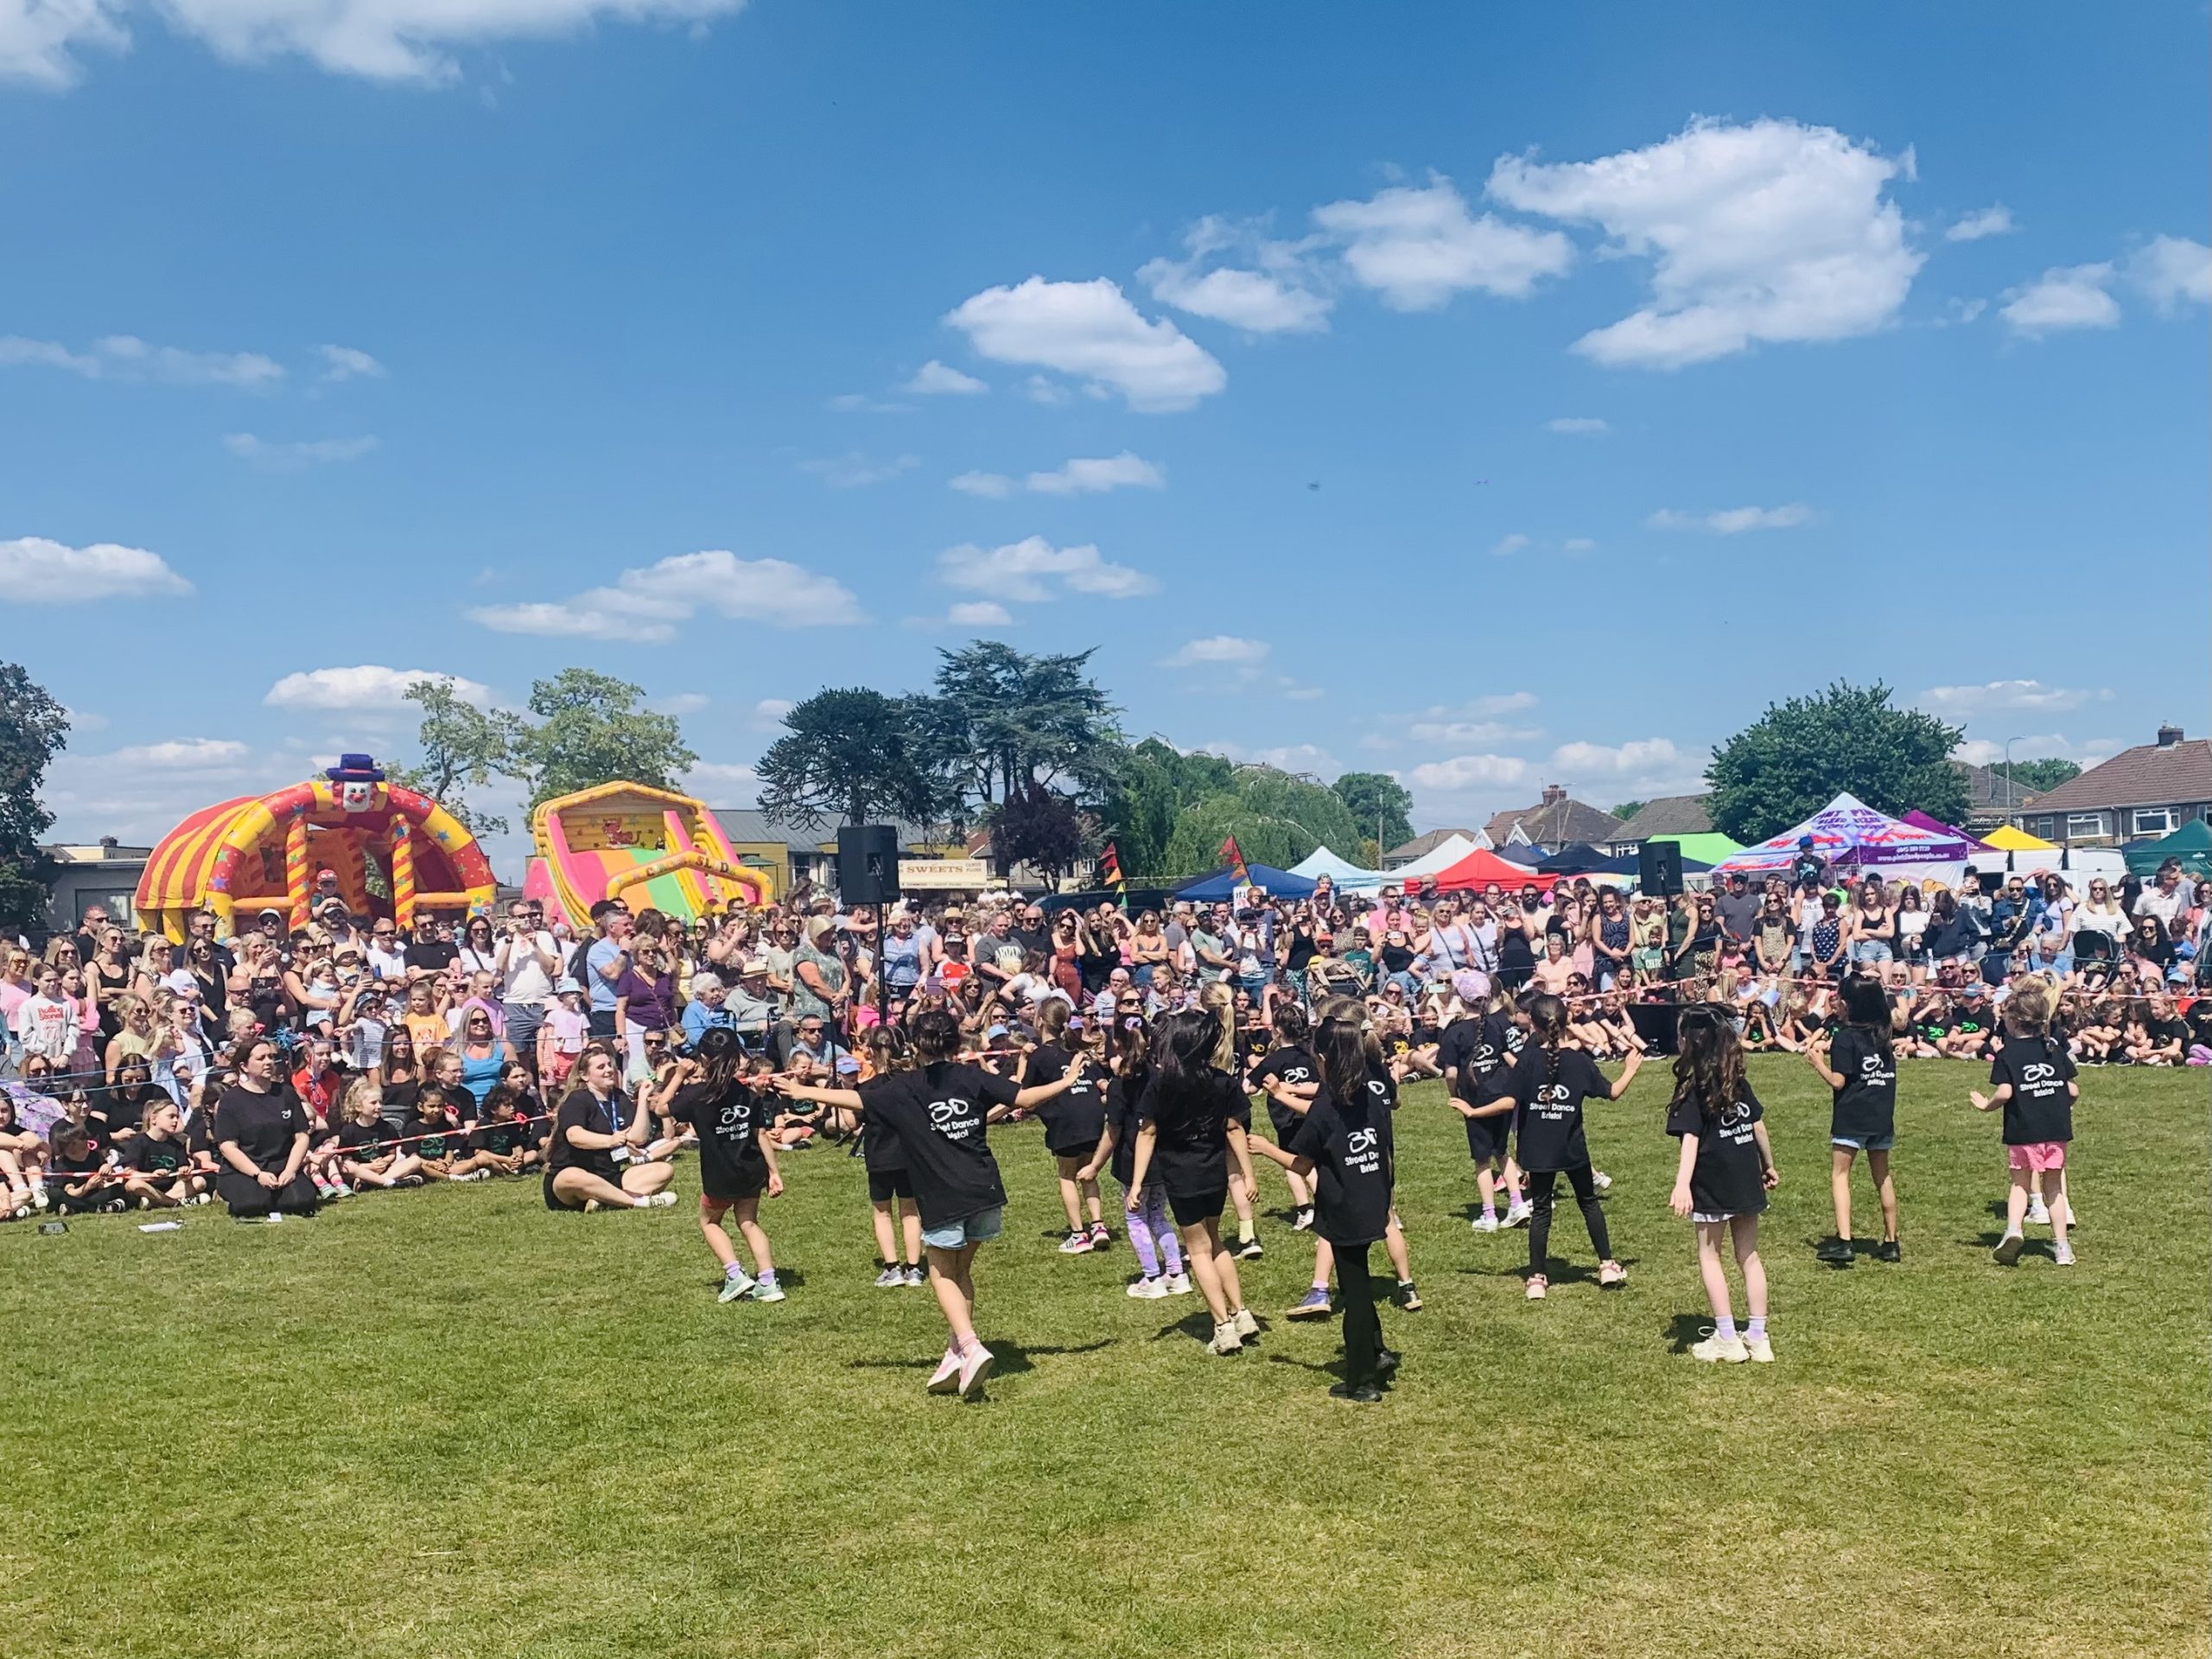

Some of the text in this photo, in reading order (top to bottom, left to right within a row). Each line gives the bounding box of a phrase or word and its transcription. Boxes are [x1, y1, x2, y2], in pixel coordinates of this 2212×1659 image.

[906, 865, 963, 874] SWEETS
[2019, 1079, 2064, 1091] Street Dance
[2033, 1087, 2056, 1097] Bristol
[1551, 1103, 1575, 1112] Dance
[1541, 1111, 1562, 1120] Bristol
[950, 1118, 980, 1130] Dance
[1344, 1153, 1368, 1166] Street
